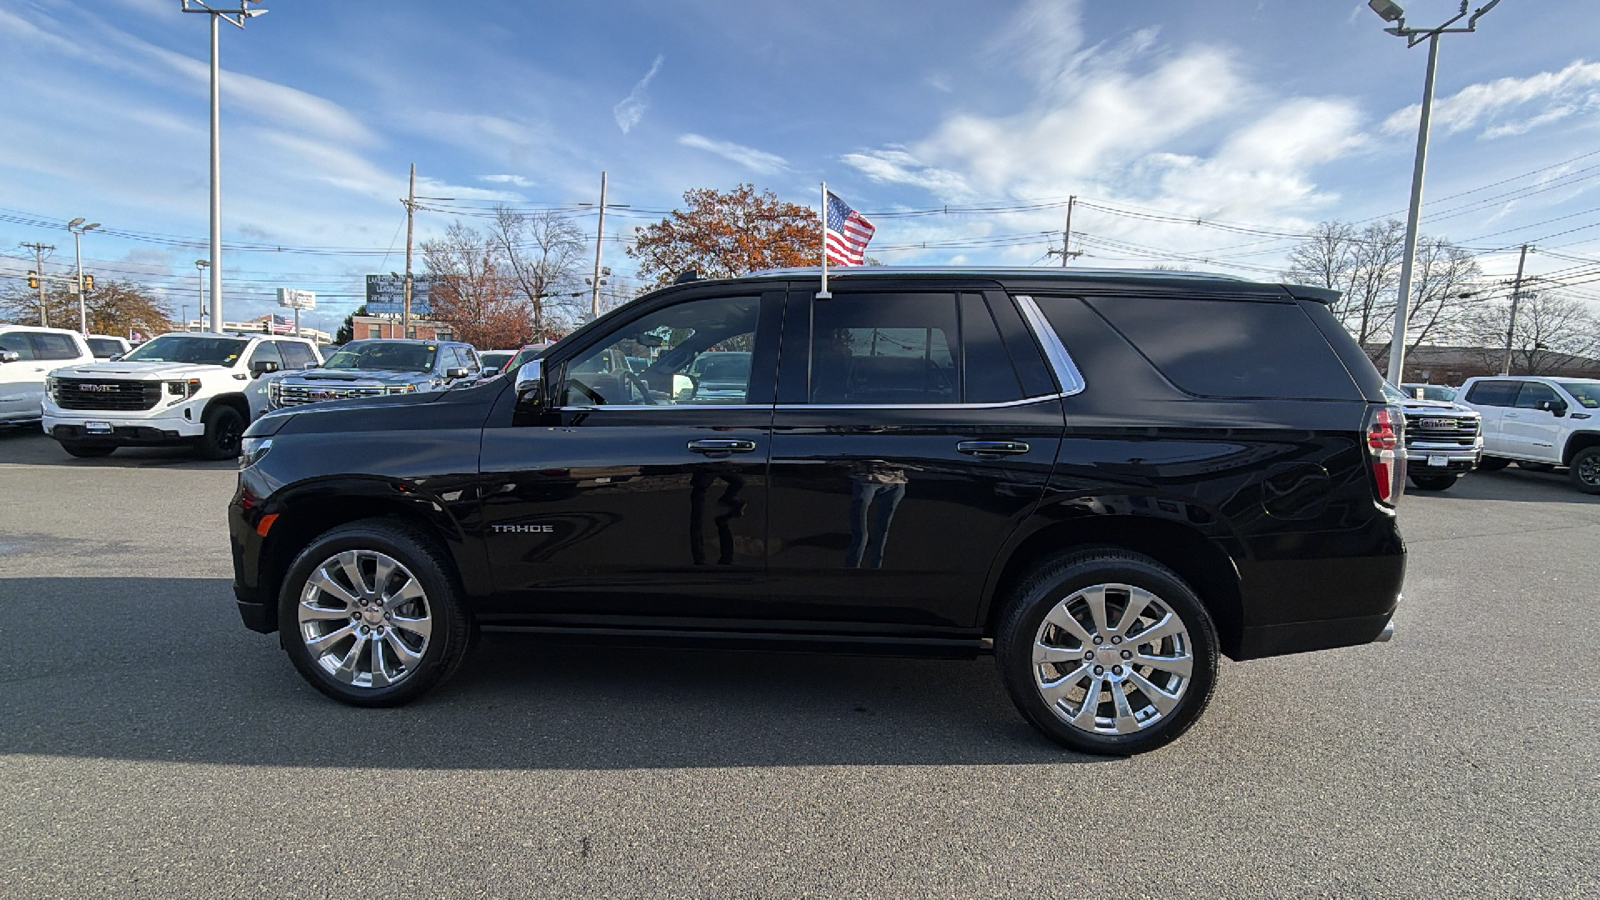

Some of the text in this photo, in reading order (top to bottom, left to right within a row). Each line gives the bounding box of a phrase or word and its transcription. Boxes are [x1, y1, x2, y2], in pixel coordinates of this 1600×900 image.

[79, 383, 120, 392] GMC
[1422, 419, 1456, 427] GMC
[491, 525, 554, 533] TAHOE
